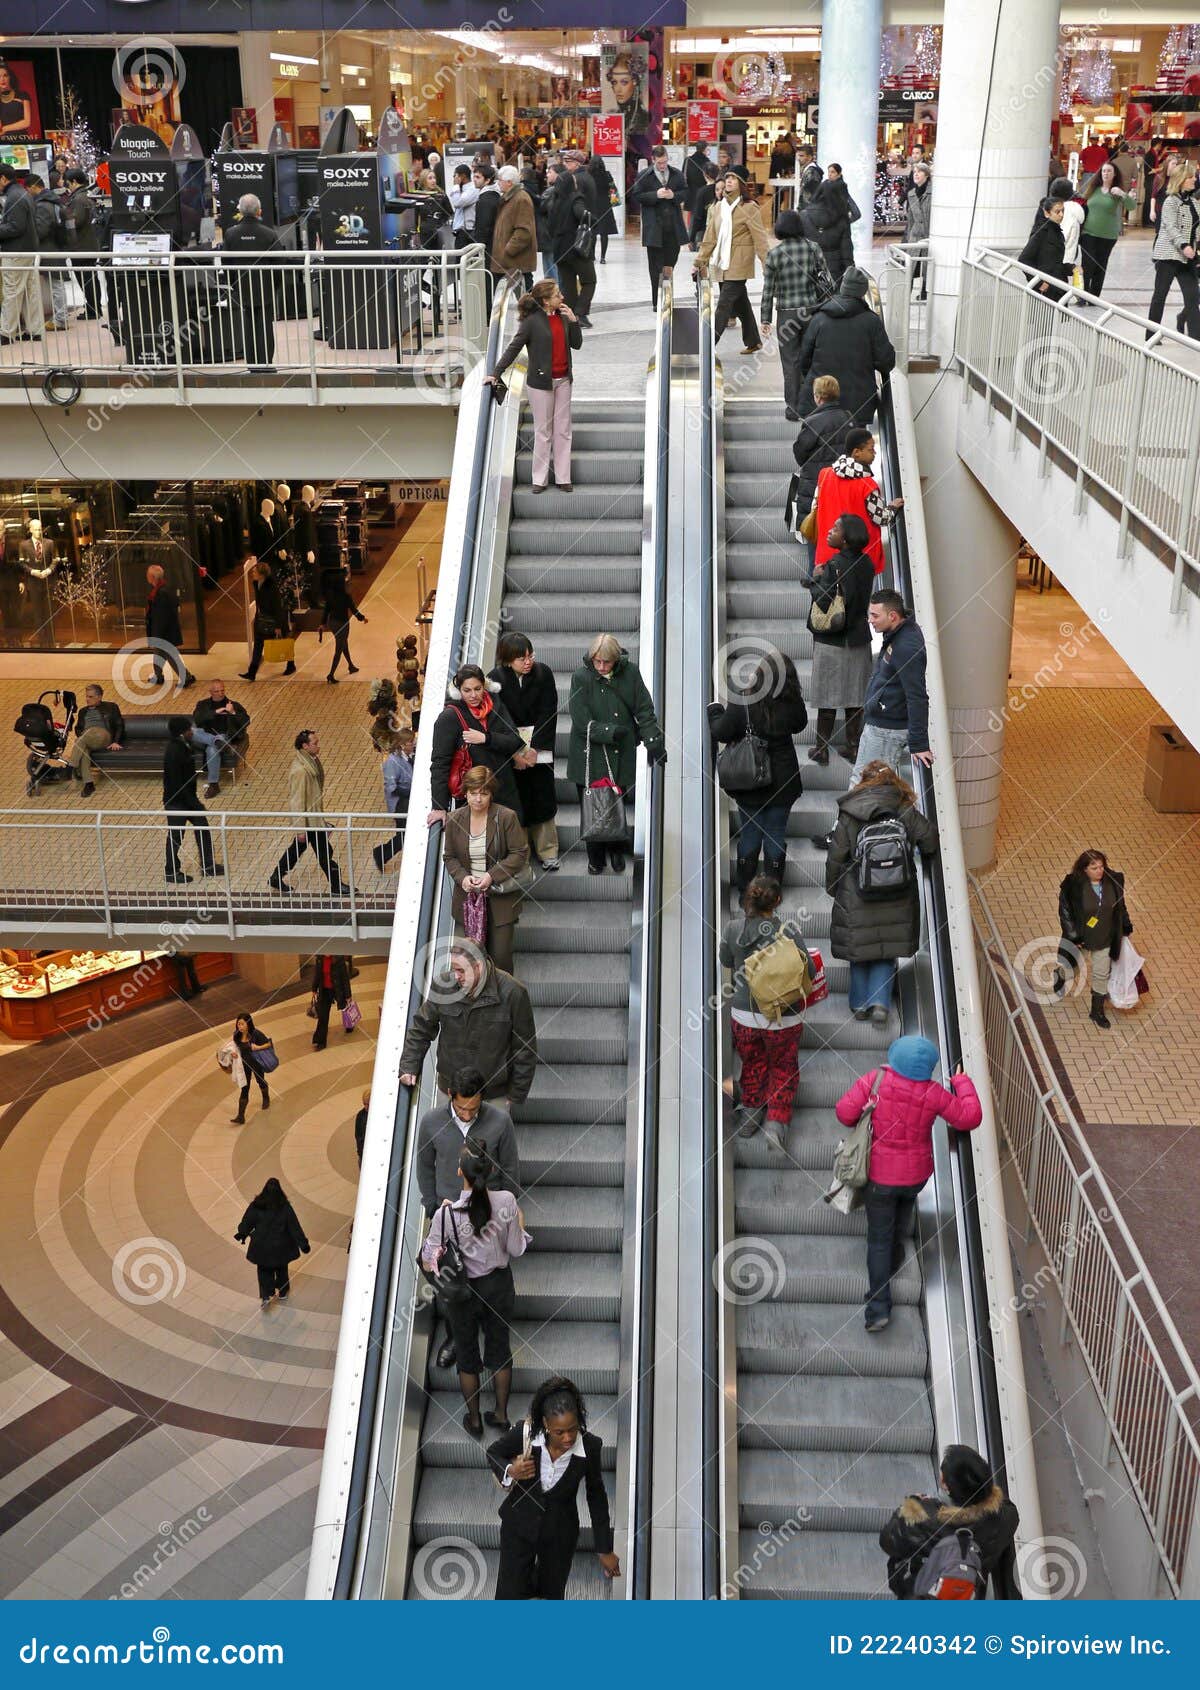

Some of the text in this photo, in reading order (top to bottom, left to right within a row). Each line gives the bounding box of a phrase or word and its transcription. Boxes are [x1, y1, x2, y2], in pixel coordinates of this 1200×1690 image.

[902, 91, 934, 100] CARGO
[128, 151, 151, 159] Touch
[223, 163, 266, 172] SONY
[115, 172, 167, 183] SONY
[323, 168, 372, 179] SONY
[339, 214, 364, 234] 3D
[399, 487, 447, 500] OPTICAL
